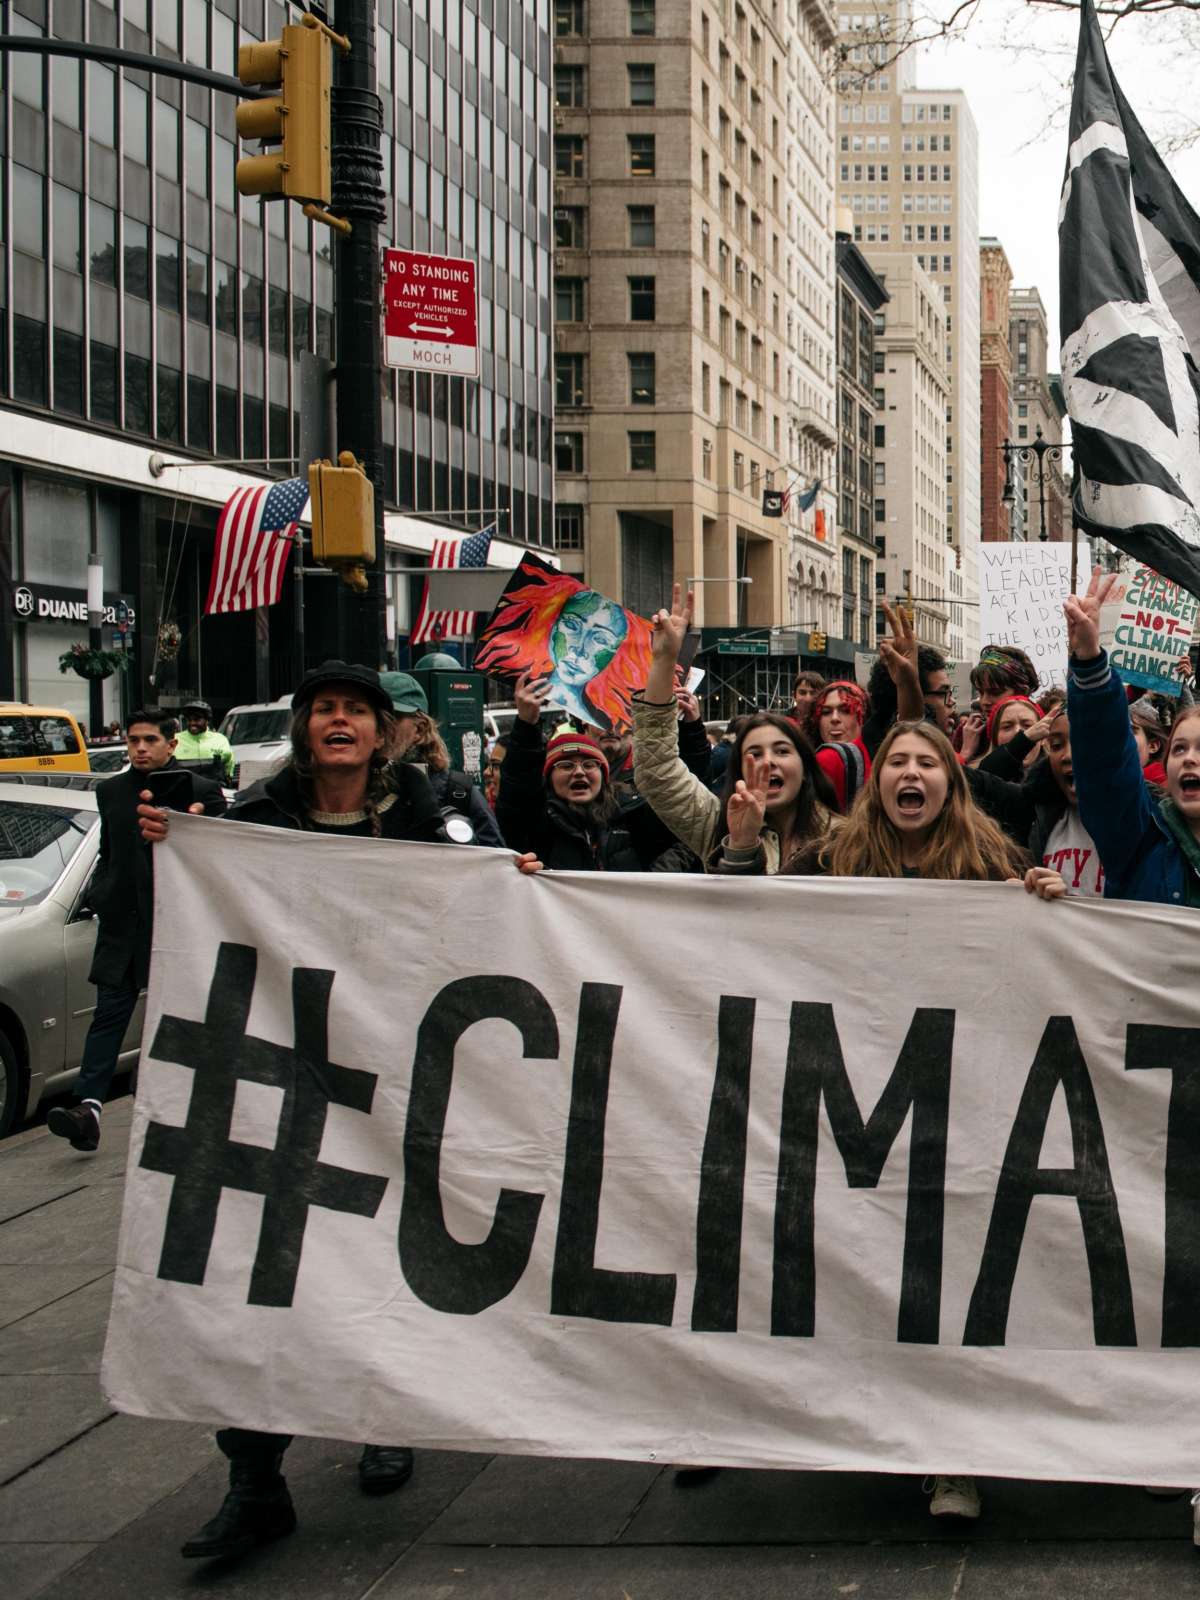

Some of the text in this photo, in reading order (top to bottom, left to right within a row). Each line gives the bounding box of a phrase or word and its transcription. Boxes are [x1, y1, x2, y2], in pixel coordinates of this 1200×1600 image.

[389, 260, 470, 283] NO STANDING
[402, 283, 459, 302] ANY TIME
[393, 300, 467, 316] EXCEPT AUTHORIZED
[414, 311, 449, 323] VEHICLES
[413, 350, 452, 365] MOCH
[982, 549, 1058, 567] WHEN
[15, 592, 33, 611] DR
[990, 588, 1068, 609] ACT LIKE
[1126, 589, 1198, 624] CHANGE!
[38, 599, 88, 620] DUANE
[1006, 604, 1064, 625] KIDS
[986, 625, 1069, 646] THE KIDS
[1115, 625, 1190, 657] CLIMATE
